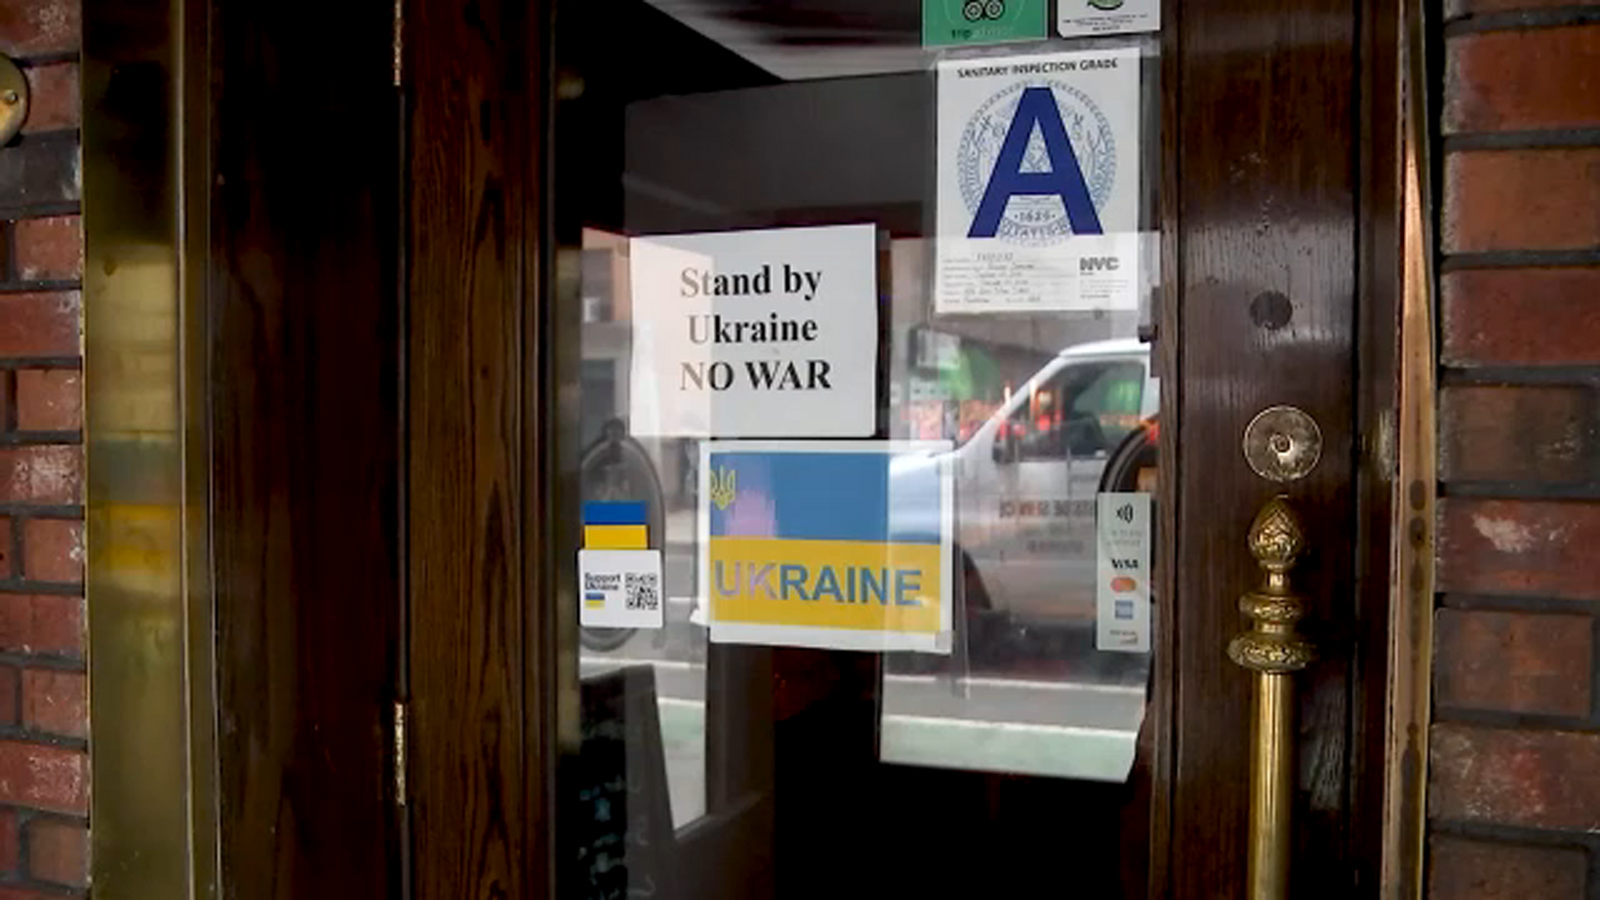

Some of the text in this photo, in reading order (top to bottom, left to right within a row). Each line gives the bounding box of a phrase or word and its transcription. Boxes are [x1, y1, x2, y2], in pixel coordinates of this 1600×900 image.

[957, 58, 1118, 78] SANITARY INSPECTION GRADE
[967, 87, 1104, 238] A
[1079, 257, 1120, 271] NYC
[680, 264, 822, 301] Stand by
[687, 312, 818, 345] Ukraine
[680, 359, 832, 391] NO WAR
[584, 573, 621, 584] Support
[1111, 558, 1139, 569] VISA
[714, 560, 923, 606] UKRAINE
